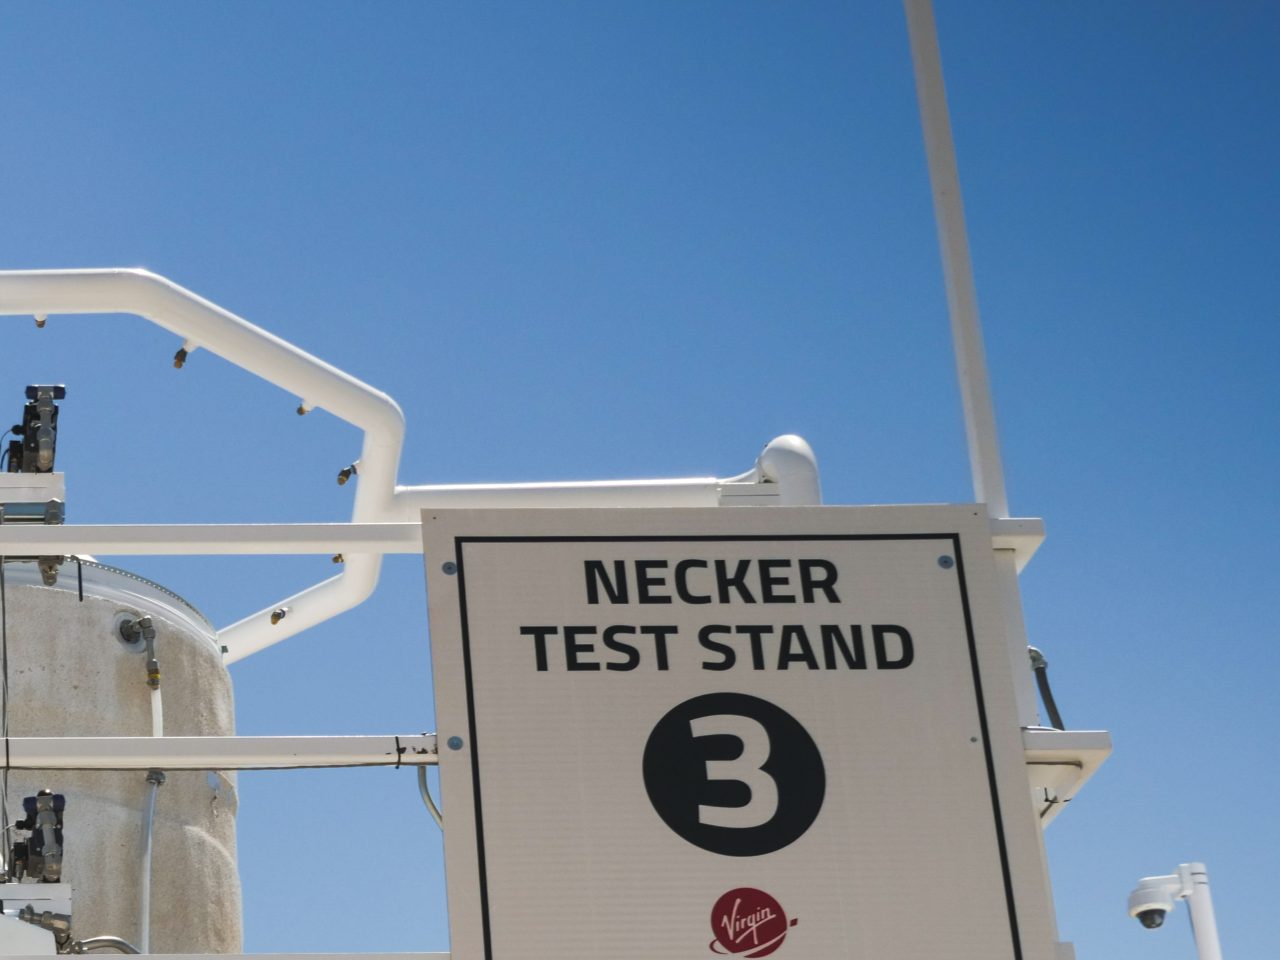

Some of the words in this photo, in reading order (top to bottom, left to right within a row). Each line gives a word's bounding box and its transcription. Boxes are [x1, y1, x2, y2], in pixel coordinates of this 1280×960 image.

[584, 559, 841, 605] NECKER
[520, 625, 679, 672] TEST
[698, 624, 915, 672] STAND
[690, 713, 780, 830] 3
[721, 898, 777, 945] Virgin
